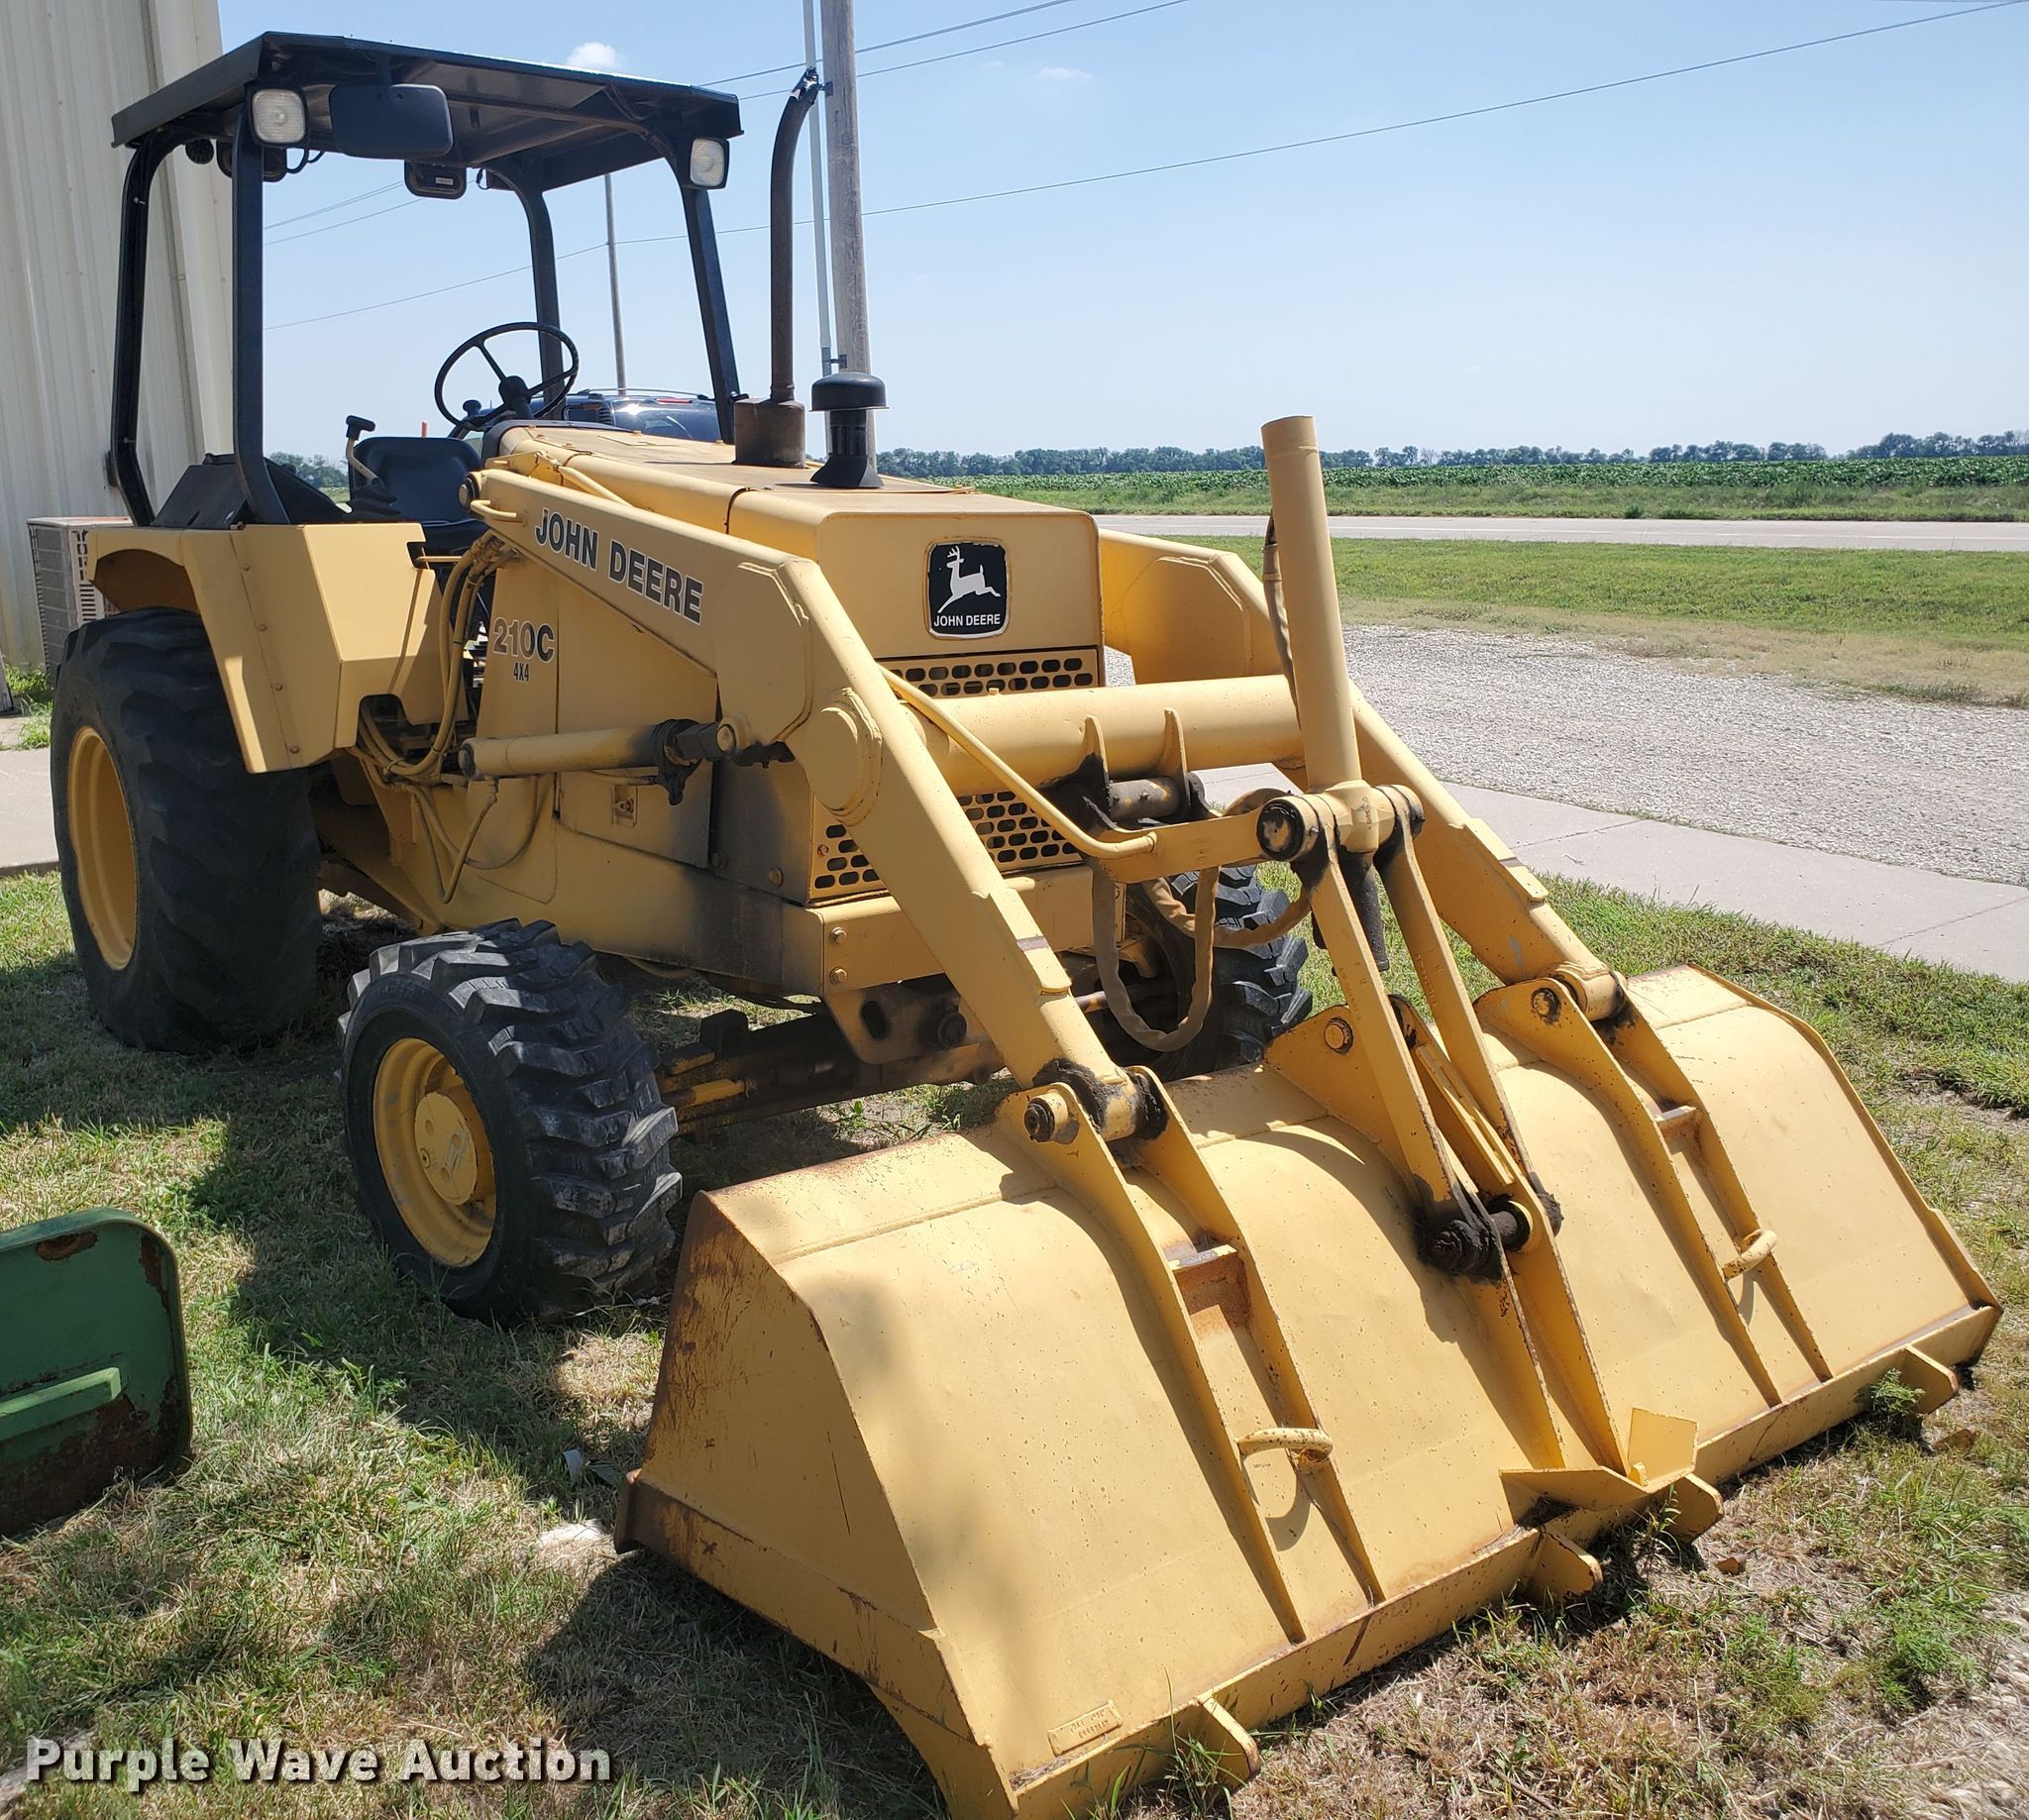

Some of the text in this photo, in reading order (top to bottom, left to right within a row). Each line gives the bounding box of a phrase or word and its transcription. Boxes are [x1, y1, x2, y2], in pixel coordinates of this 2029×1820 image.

[535, 507, 703, 626] JOHN DEERE
[933, 613, 1001, 627] JOHN DEERE
[492, 616, 556, 664] 210C
[513, 662, 530, 683] 4X4
